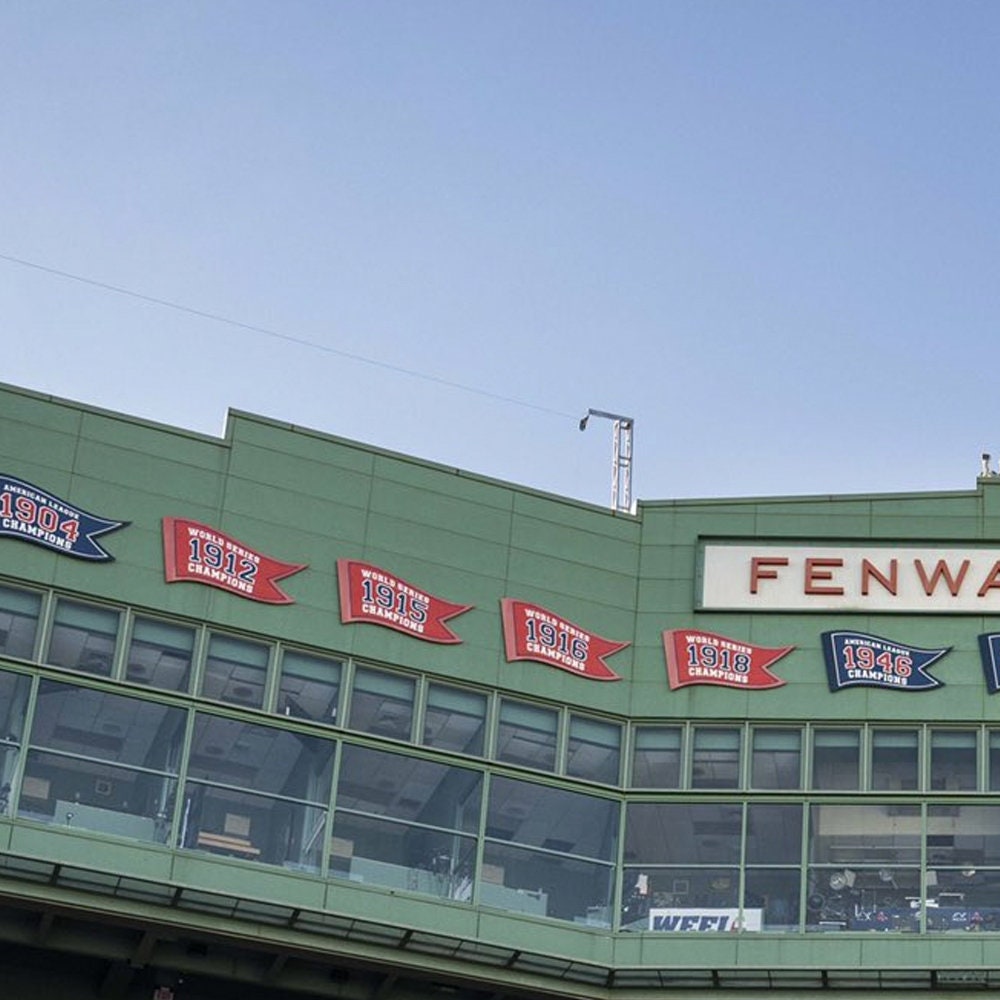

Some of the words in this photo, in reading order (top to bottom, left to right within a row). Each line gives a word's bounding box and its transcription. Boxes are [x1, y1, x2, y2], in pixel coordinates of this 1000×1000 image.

[0, 492, 80, 542] 1904
[4, 484, 47, 504] AMERICAN
[48, 500, 80, 519] LEAGUE
[2, 518, 73, 549] CHAMPIONS
[188, 527, 225, 546] WORLD
[226, 542, 260, 563] SERIES
[189, 537, 259, 584] 1912
[187, 563, 254, 593] CHAMPIONS
[361, 569, 396, 587] WORLD
[397, 583, 430, 603] SERIES
[362, 579, 429, 623] 1915
[361, 604, 424, 633] CHAMPIONS
[524, 608, 557, 626] WORLD
[559, 621, 590, 641] SERIES
[525, 618, 589, 662] 1916
[685, 635, 719, 647] WORLD
[720, 640, 752, 654] SERIES
[844, 639, 881, 649] AMERICAN
[882, 644, 910, 656] LEAGUE
[526, 642, 585, 671] CHAMPIONS
[687, 644, 751, 674] 1918
[843, 645, 912, 677] 1946
[688, 667, 748, 683] CHAMPIONS
[848, 669, 908, 685] CHAMPIONS
